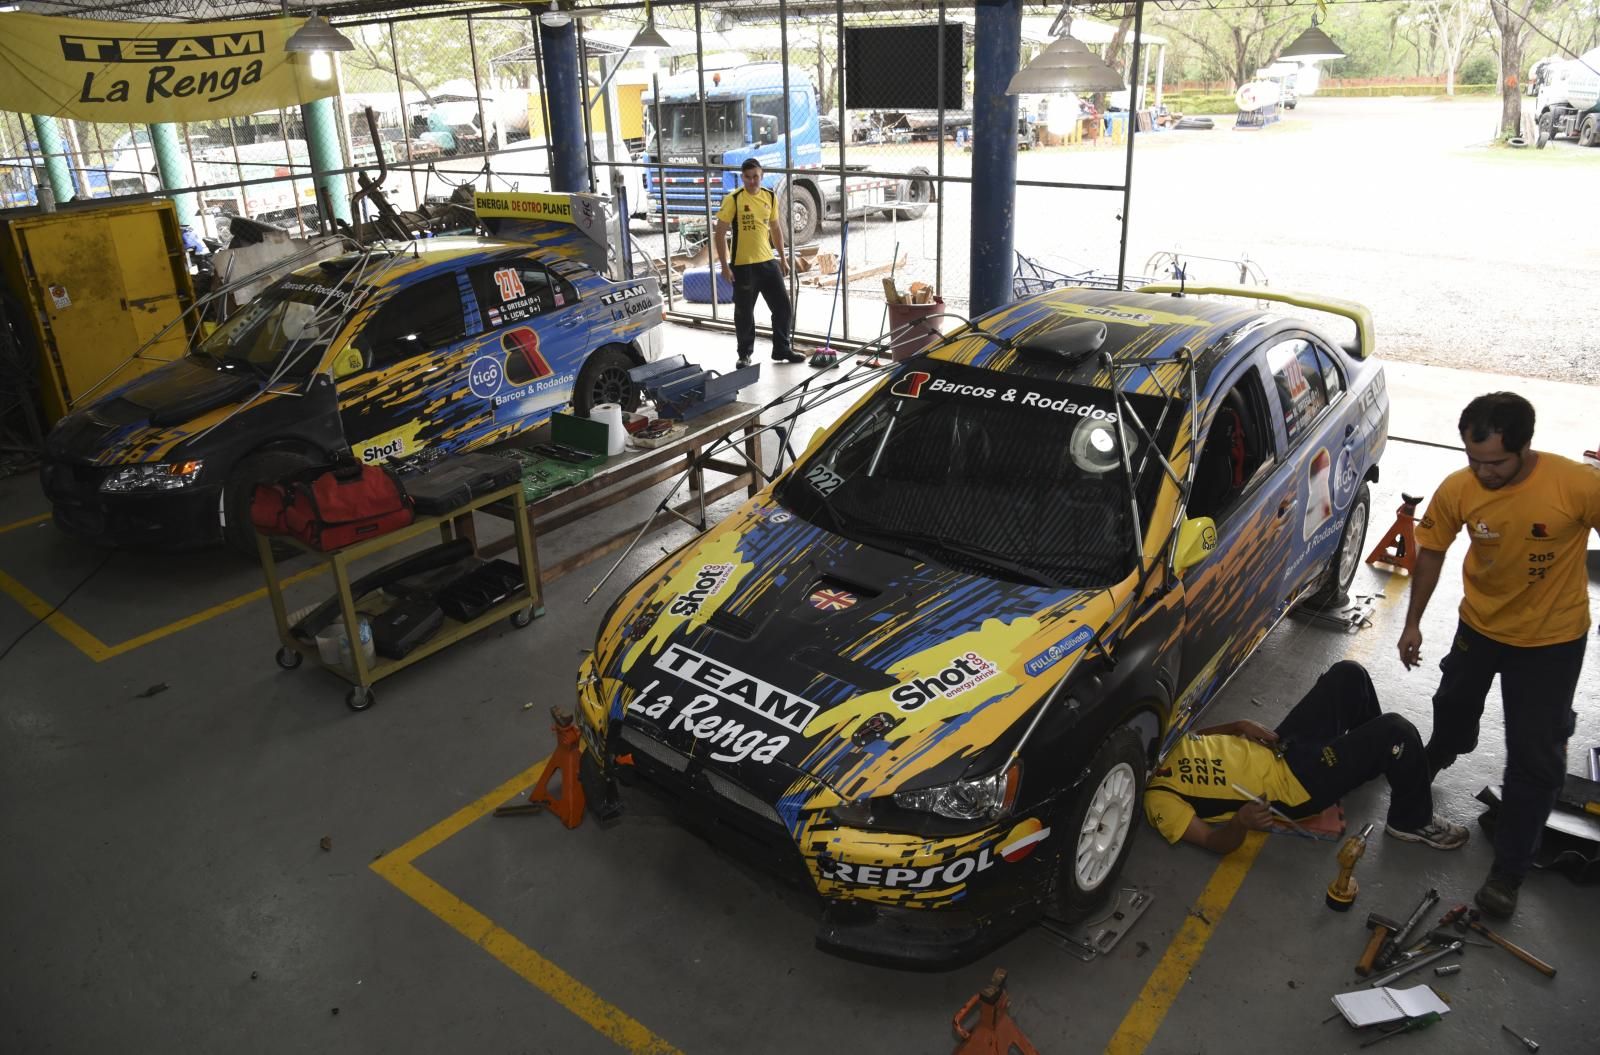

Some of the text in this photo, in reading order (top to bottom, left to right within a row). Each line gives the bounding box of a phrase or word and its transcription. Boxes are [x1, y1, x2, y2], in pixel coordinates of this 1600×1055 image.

[63, 33, 261, 61] TEAM
[79, 60, 262, 103] La Renga
[668, 156, 698, 165] SCANIA
[476, 198, 571, 216] ENERGIA DE OTRO PLANET
[495, 268, 526, 301] 274
[602, 286, 646, 304] TEAM
[507, 300, 529, 311] ORTEGA
[473, 365, 498, 386] tigo
[495, 374, 574, 405] Barcos & Rodados
[928, 379, 1118, 424] Barcos & Rodados
[363, 440, 399, 462] Shot
[807, 467, 842, 495] 222
[1528, 552, 1555, 562] 205
[671, 571, 723, 616] Shot
[1030, 654, 1053, 673] FULL
[668, 647, 811, 728] TEAM
[892, 657, 980, 711] Shot
[946, 667, 996, 698] energy drink
[627, 680, 790, 764] La Renga
[1178, 758, 1194, 784] 205
[1194, 758, 1209, 785] 222
[1211, 759, 1226, 786] 274
[823, 849, 995, 888] REPSOL
